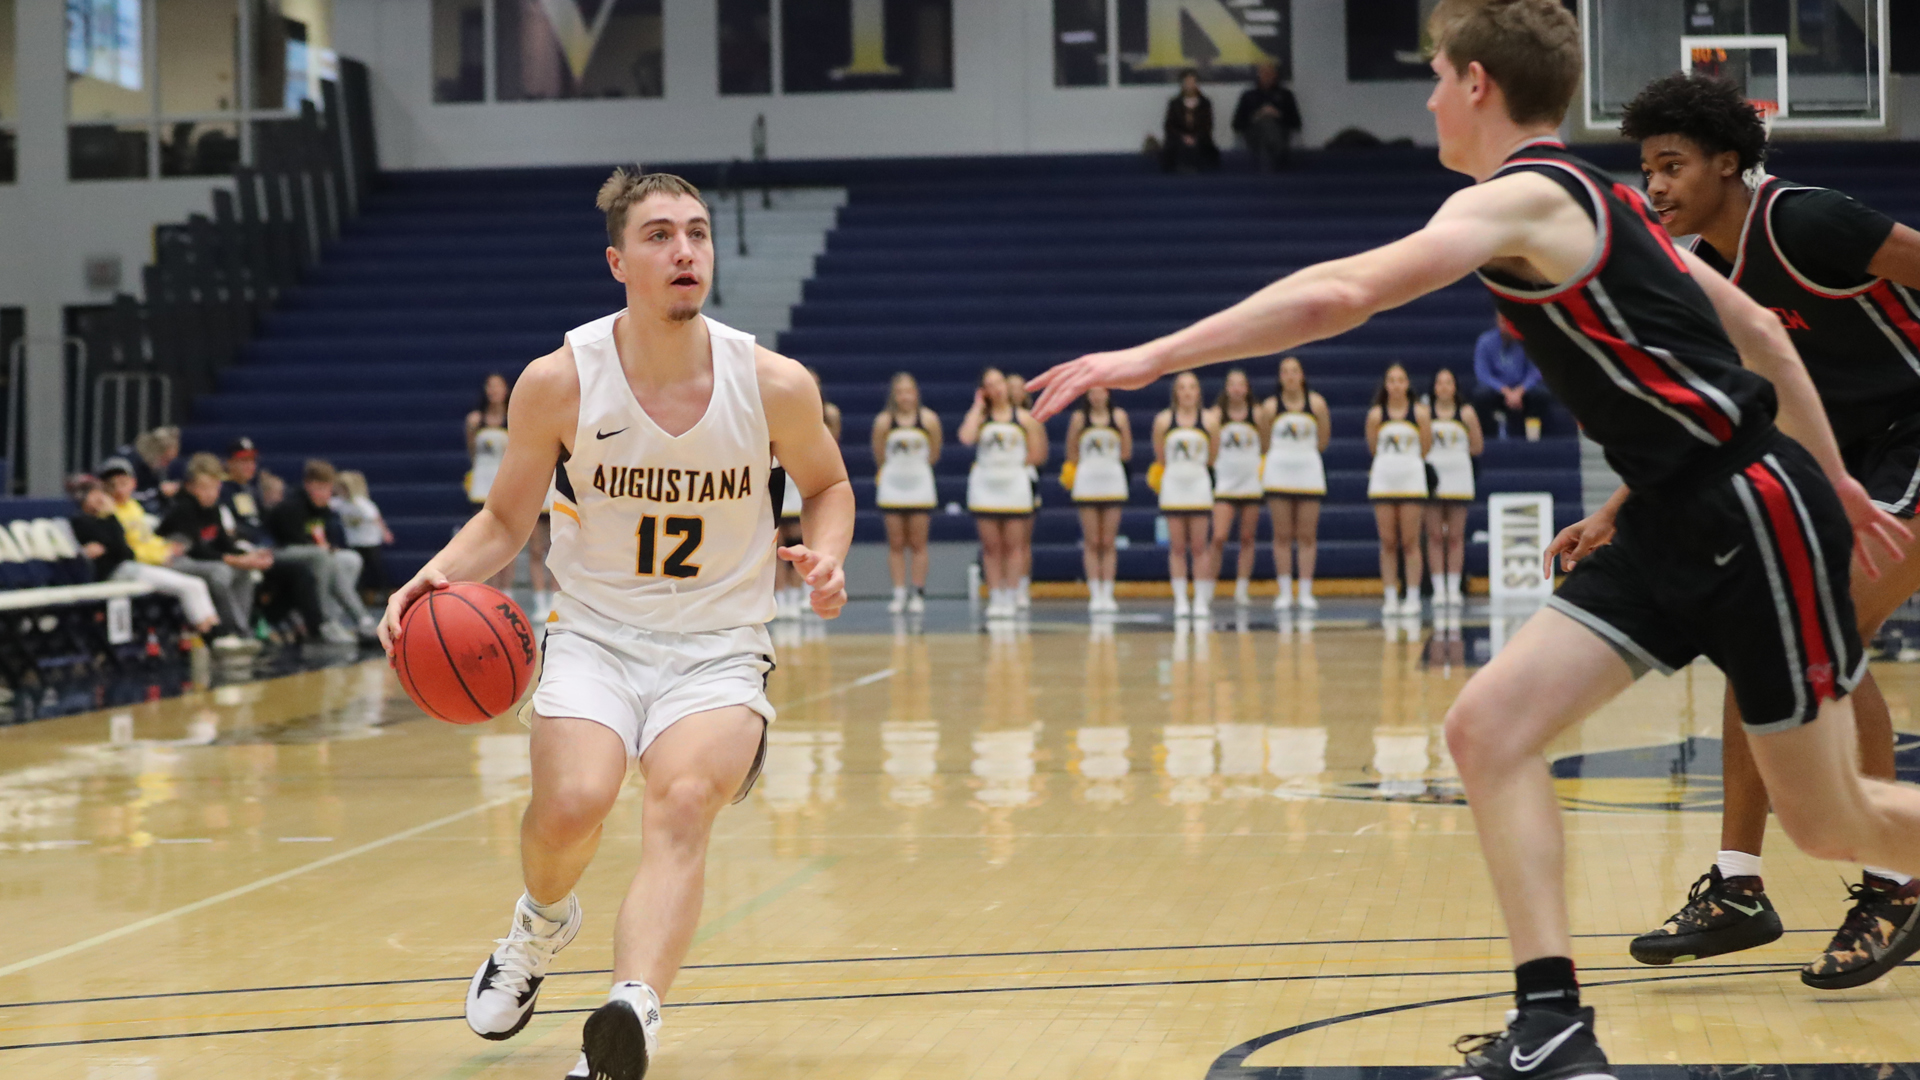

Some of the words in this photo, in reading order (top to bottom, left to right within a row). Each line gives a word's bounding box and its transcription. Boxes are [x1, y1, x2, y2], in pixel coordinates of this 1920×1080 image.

[592, 463, 752, 504] AUGUSTANA
[635, 512, 705, 580] 12
[1502, 504, 1540, 588] VIKES
[496, 603, 534, 666] NCAA
